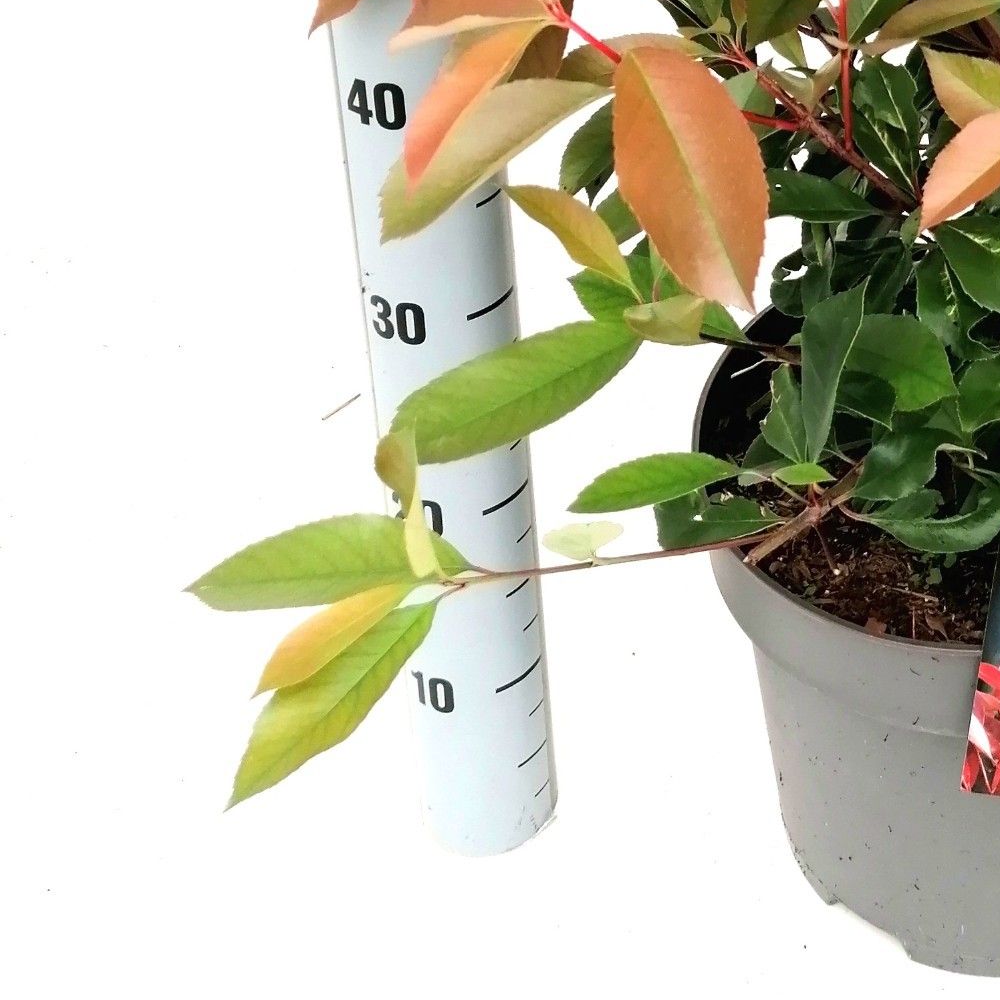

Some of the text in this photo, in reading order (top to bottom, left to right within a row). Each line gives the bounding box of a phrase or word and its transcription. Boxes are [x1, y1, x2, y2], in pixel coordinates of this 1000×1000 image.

[348, 79, 407, 131] 40
[371, 296, 425, 345] 30
[392, 491, 443, 536] 0
[412, 670, 455, 714] 10
